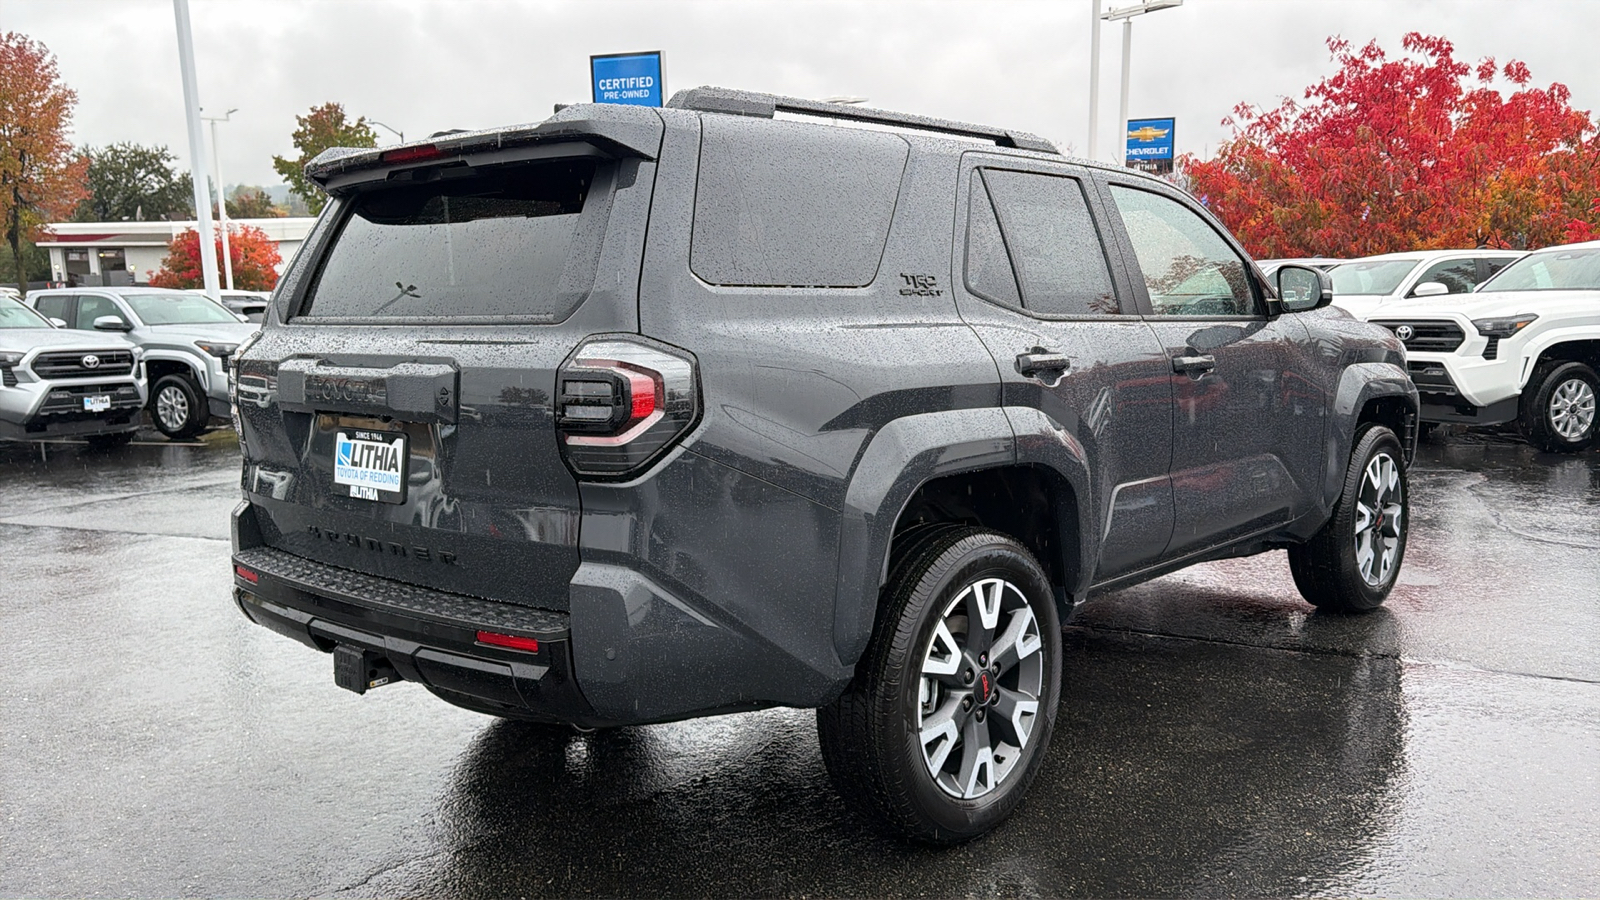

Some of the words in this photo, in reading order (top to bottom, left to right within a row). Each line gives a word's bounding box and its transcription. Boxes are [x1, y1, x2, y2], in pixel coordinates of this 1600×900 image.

[599, 76, 654, 90] CERTIFIED
[604, 89, 650, 100] PRE-OWNED
[355, 431, 371, 440] SINCE
[371, 433, 383, 441] 1946
[350, 443, 399, 473] LITHIA
[337, 467, 359, 480] TOYOTA
[360, 470, 369, 480] OF
[369, 471, 399, 485] REDDING
